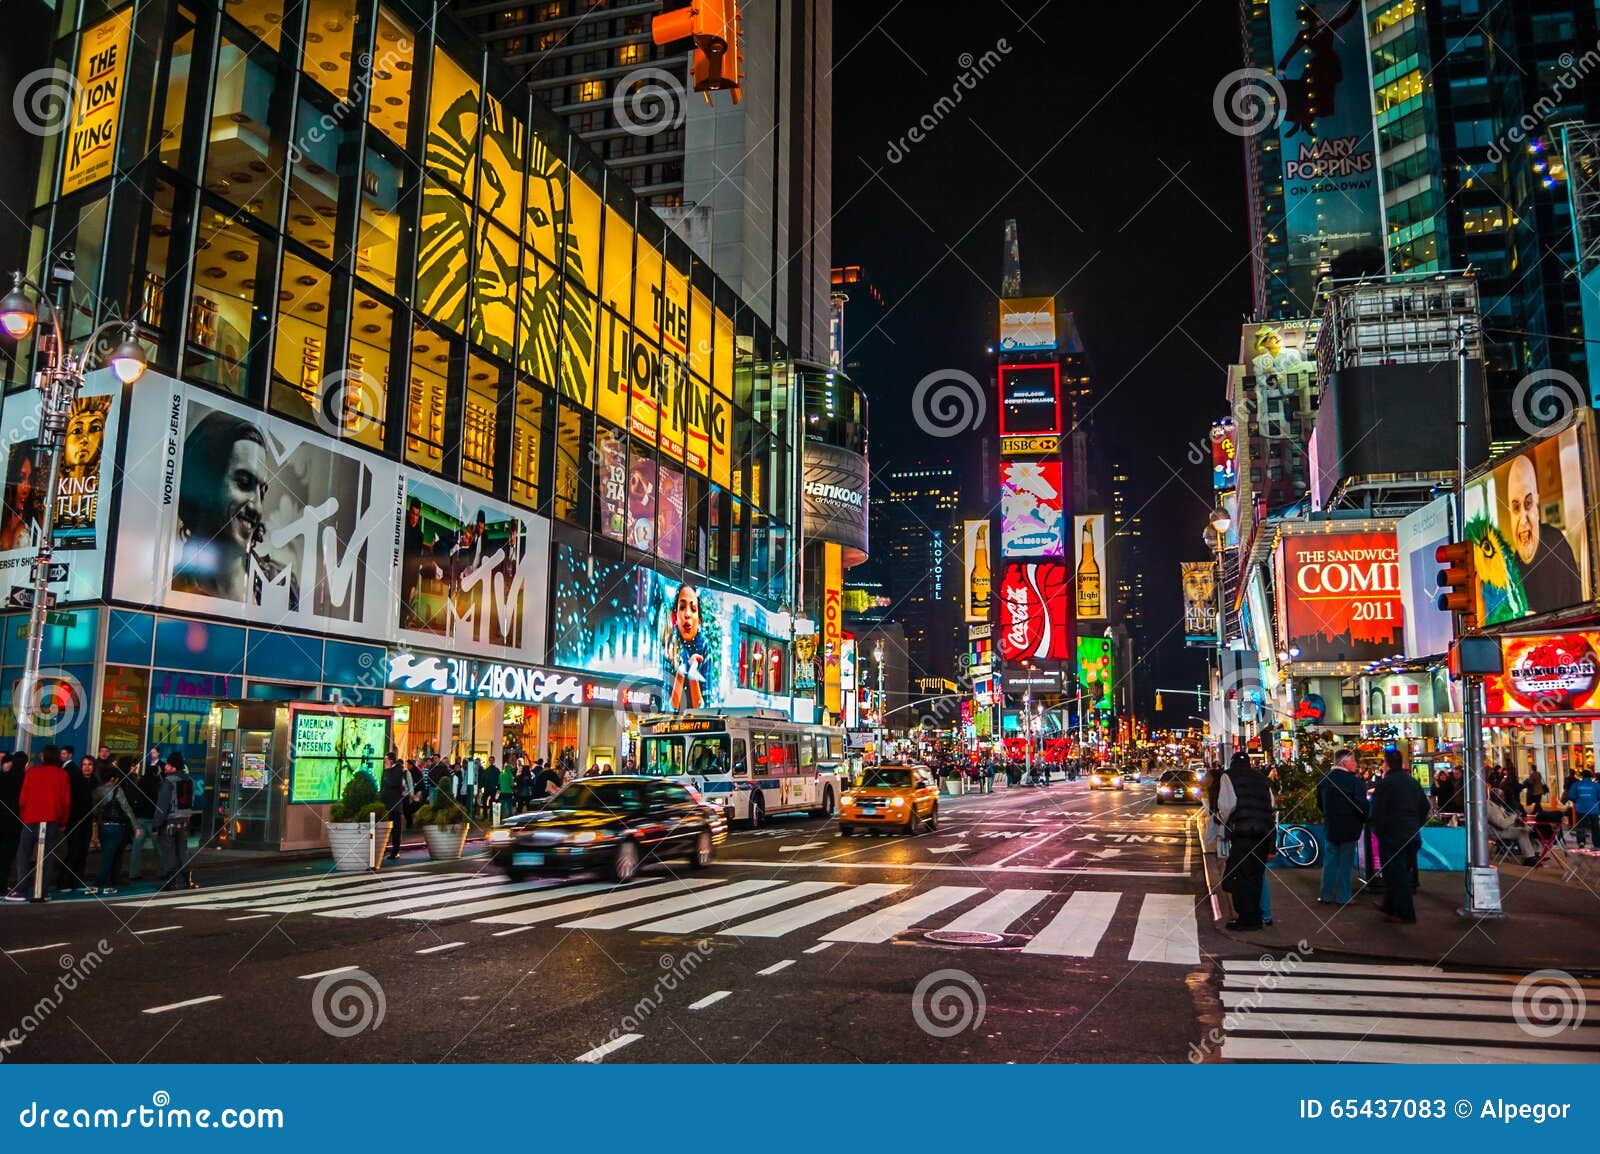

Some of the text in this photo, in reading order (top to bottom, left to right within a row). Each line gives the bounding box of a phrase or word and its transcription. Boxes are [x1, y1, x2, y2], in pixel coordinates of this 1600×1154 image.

[89, 44, 117, 78] THE
[77, 77, 118, 126] LION
[70, 119, 112, 171] KING
[1299, 136, 1357, 162] MARY
[1286, 153, 1373, 180] POPPINS
[1290, 181, 1372, 196] ON BROADWAY
[651, 283, 687, 345] THE
[607, 300, 725, 445] LION KING
[163, 393, 182, 505] WORLD OF JENKS
[661, 436, 670, 448] ON
[687, 450, 700, 466] STREET
[1003, 440, 1038, 451] HSBC
[57, 475, 97, 495] KING
[396, 484, 404, 505] LIFE
[57, 494, 95, 517] TUT
[815, 496, 840, 508] driving
[394, 507, 402, 546] BURIED
[0, 558, 20, 569] ERSEY
[392, 547, 400, 569] THE
[1296, 550, 1326, 563] THE
[934, 539, 943, 600] NOVOTEL
[1297, 562, 1400, 593] COMI
[1184, 606, 1216, 618] KING
[1351, 601, 1394, 620] 2011
[1186, 617, 1215, 631] TUT
[446, 657, 548, 702] BILABONG
[1511, 662, 1595, 678] BAKUGAN
[298, 740, 332, 753] PRESENTS
[1073, 833, 1180, 843] ONLY
